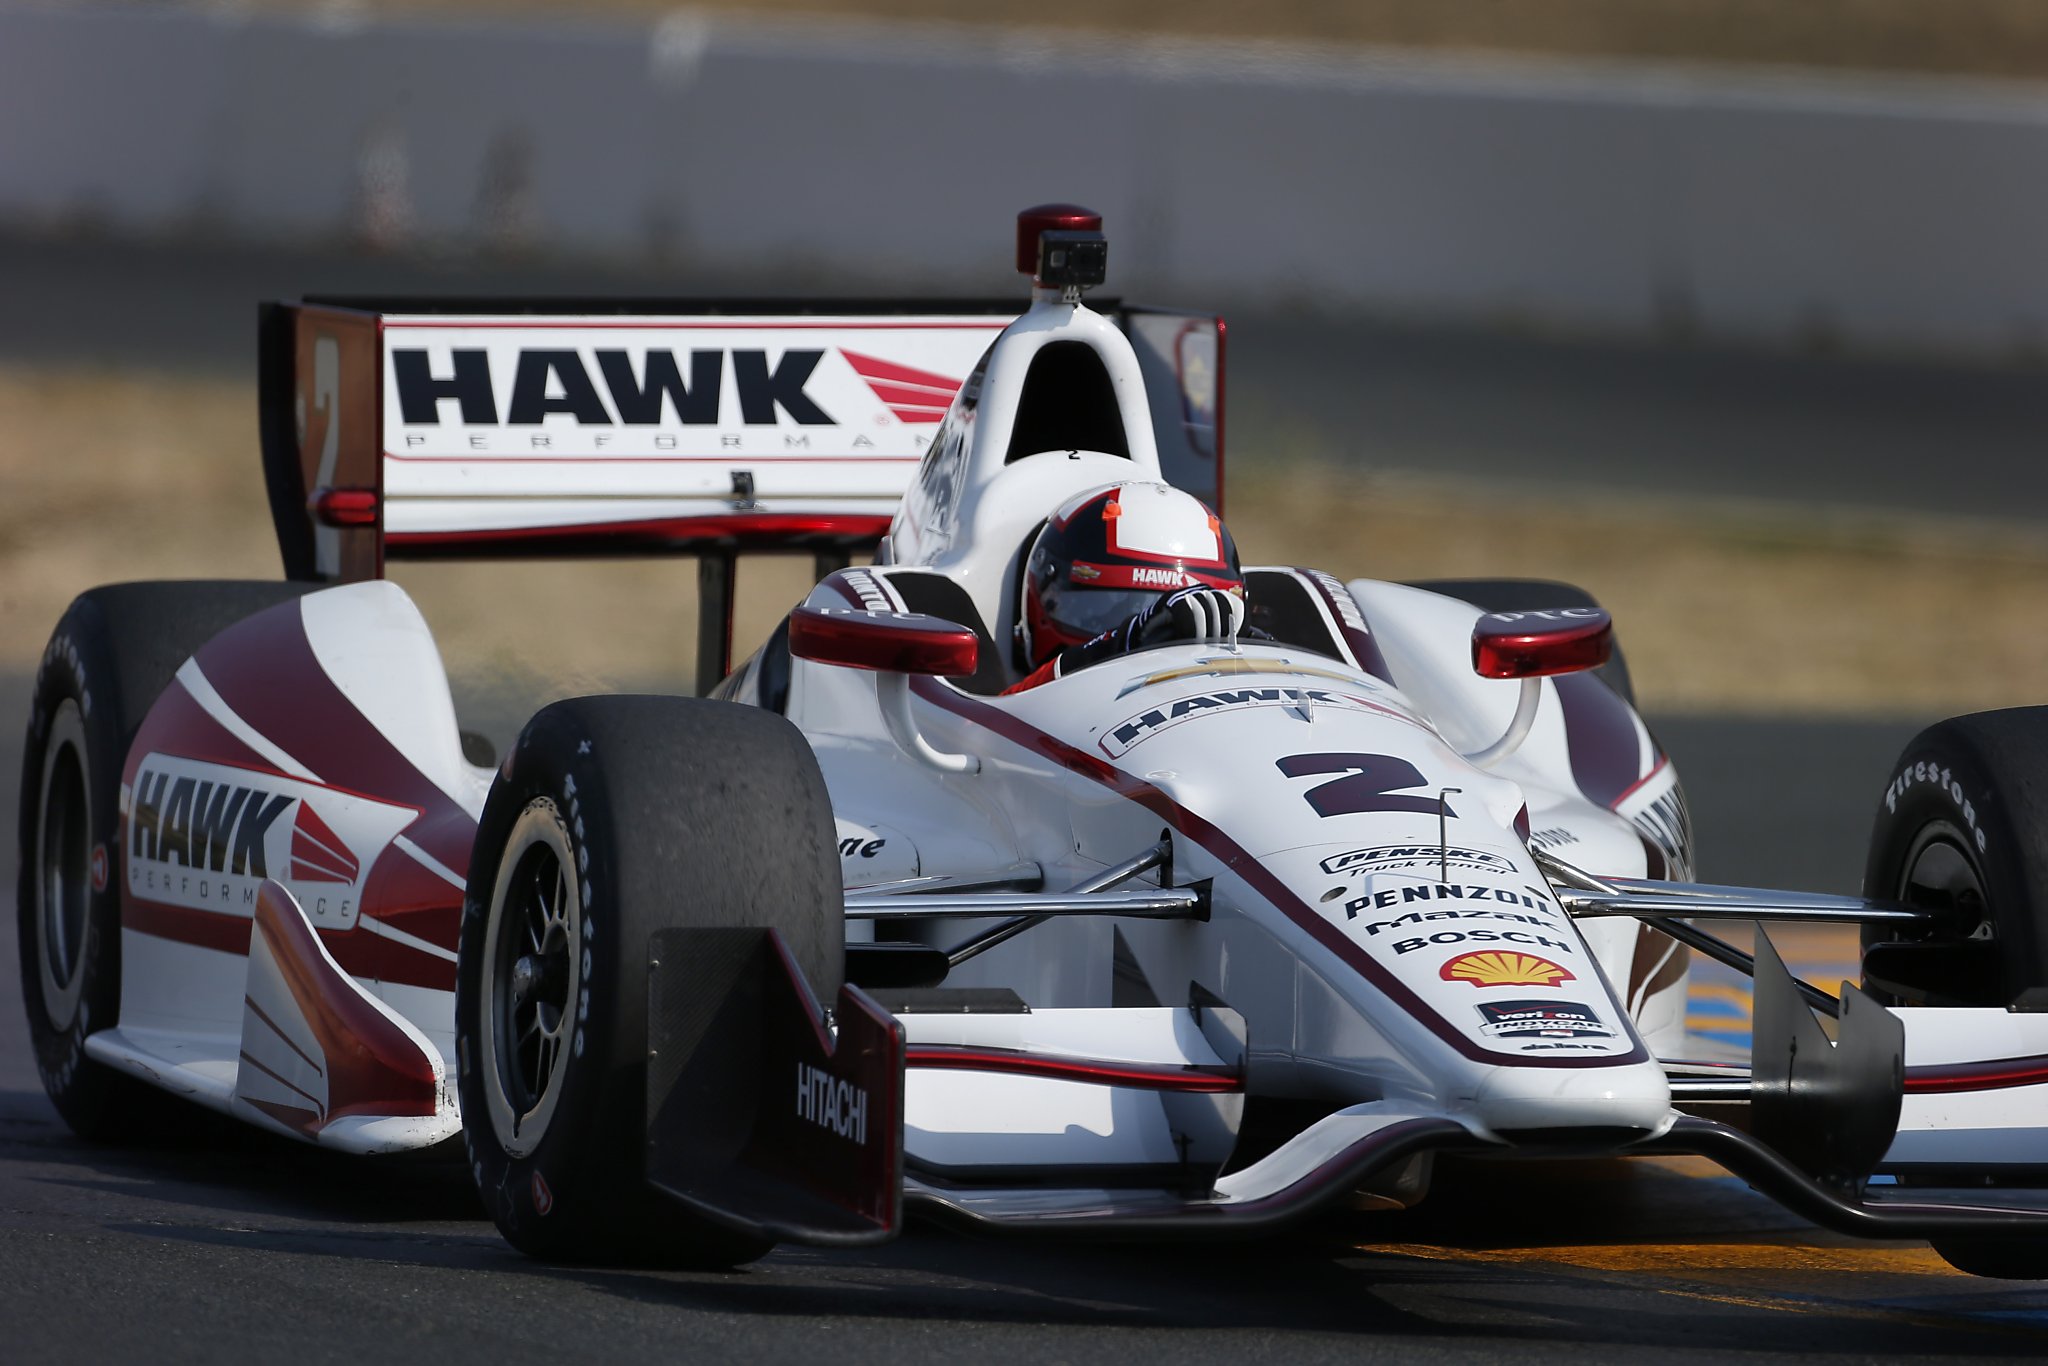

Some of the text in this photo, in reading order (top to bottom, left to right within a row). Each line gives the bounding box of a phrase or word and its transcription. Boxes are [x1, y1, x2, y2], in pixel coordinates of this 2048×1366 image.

[391, 348, 839, 425] HAWK
[406, 433, 932, 450] PERFORMAN
[1132, 568, 1183, 586] HAWK
[1113, 689, 1339, 744] HAWK
[1275, 753, 1460, 819] 2
[1886, 761, 1986, 853] Firestone
[133, 769, 297, 879] HAWK
[838, 838, 887, 858] ne
[1336, 847, 1502, 869] PENSKE
[1349, 860, 1417, 877] Truck
[132, 868, 351, 917] PERFORMCE
[1345, 884, 1559, 921] PENNZOIL
[1365, 910, 1564, 936] Mazak
[1391, 930, 1573, 955] BOSCH
[1495, 1020, 1603, 1030] INDYCAR
[1497, 1011, 1586, 1021] verizon
[798, 1062, 867, 1145] HITACHI
